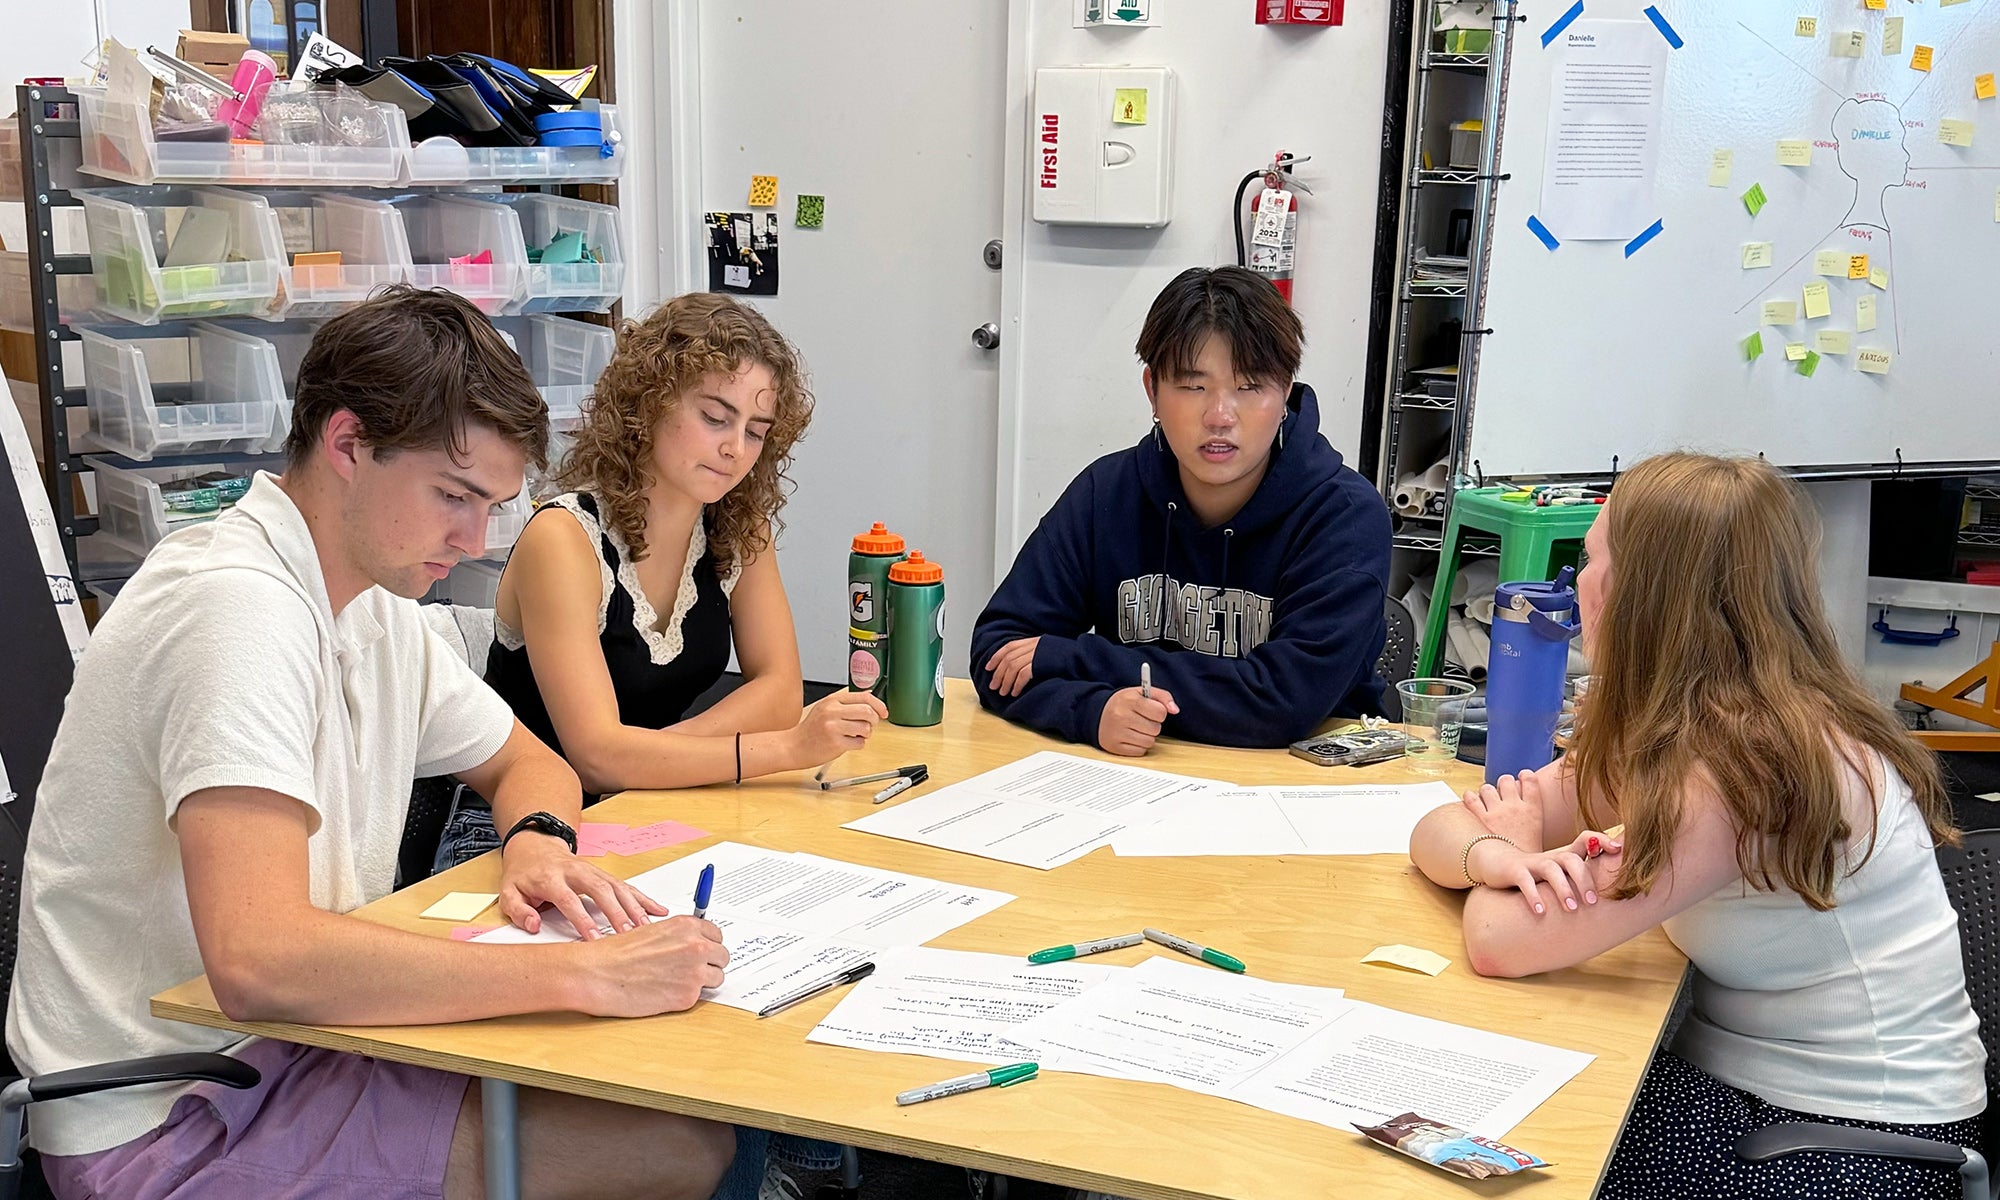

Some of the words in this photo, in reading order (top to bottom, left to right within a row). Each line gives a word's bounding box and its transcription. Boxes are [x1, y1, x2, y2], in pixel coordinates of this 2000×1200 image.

[1042, 114, 1059, 144] Aid
[1851, 129, 1891, 140] DANIELLE
[1041, 148, 1058, 188] First
